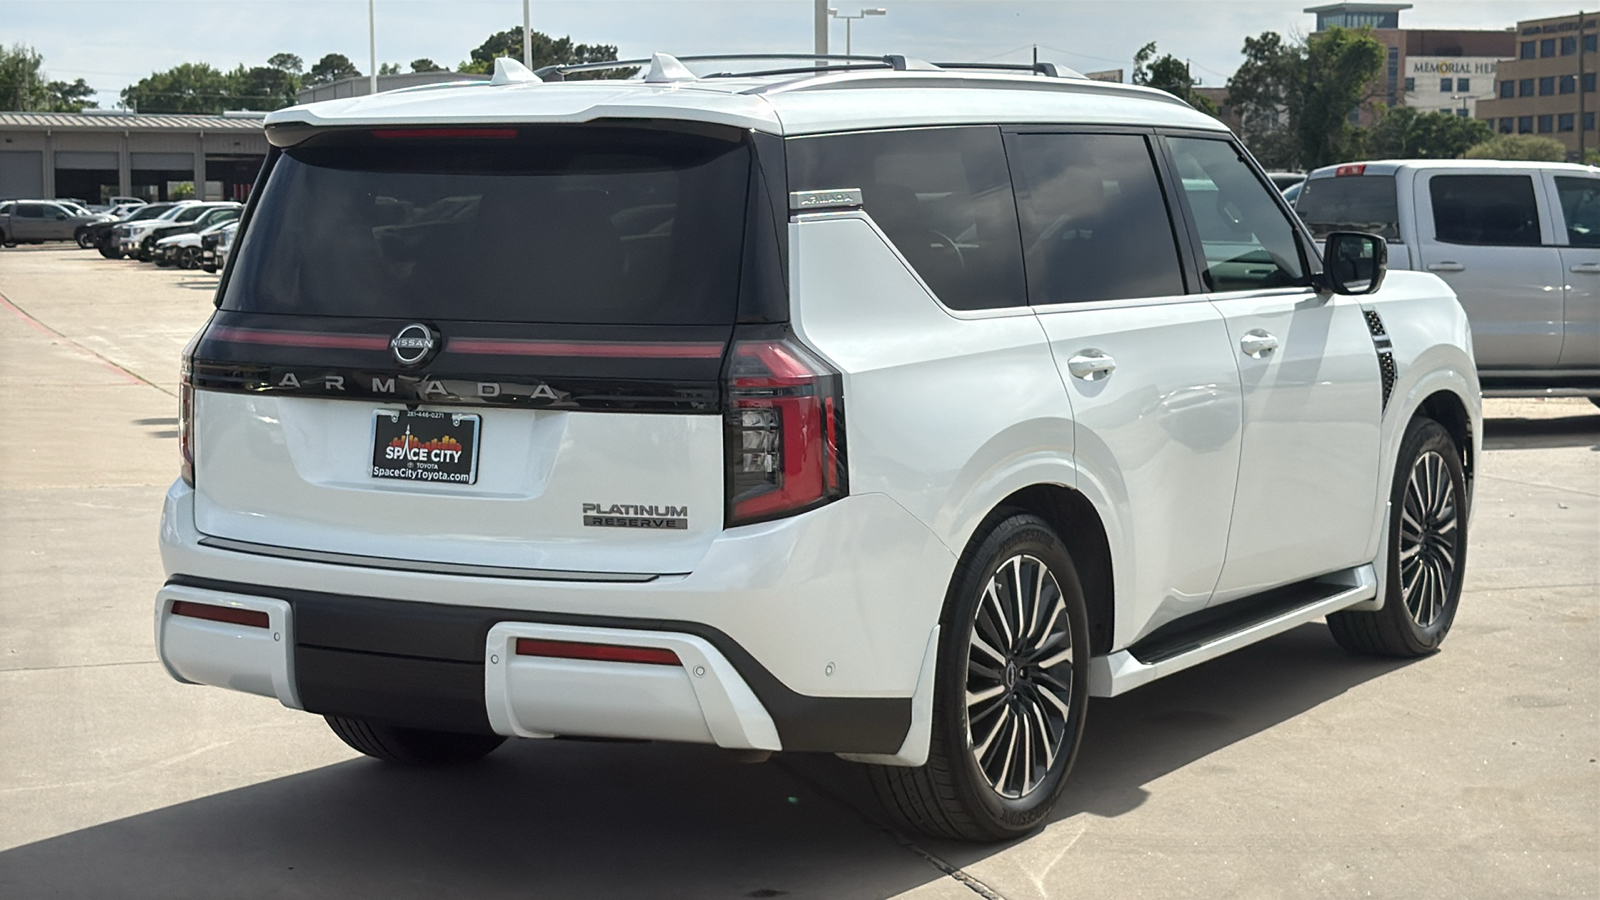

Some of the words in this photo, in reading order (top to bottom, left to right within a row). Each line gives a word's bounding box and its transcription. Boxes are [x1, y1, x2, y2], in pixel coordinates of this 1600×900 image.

[1413, 61, 1471, 75] MEMORIAL
[391, 338, 433, 349] NISSAN
[278, 372, 558, 400] ARMADA
[385, 445, 428, 461] SPACE
[431, 449, 462, 463] CITY
[416, 462, 439, 470] TOYOTA
[373, 466, 469, 482] SpaceCityToyota.com
[582, 503, 688, 517] PLATINUM
[592, 517, 677, 528] RESERVE
